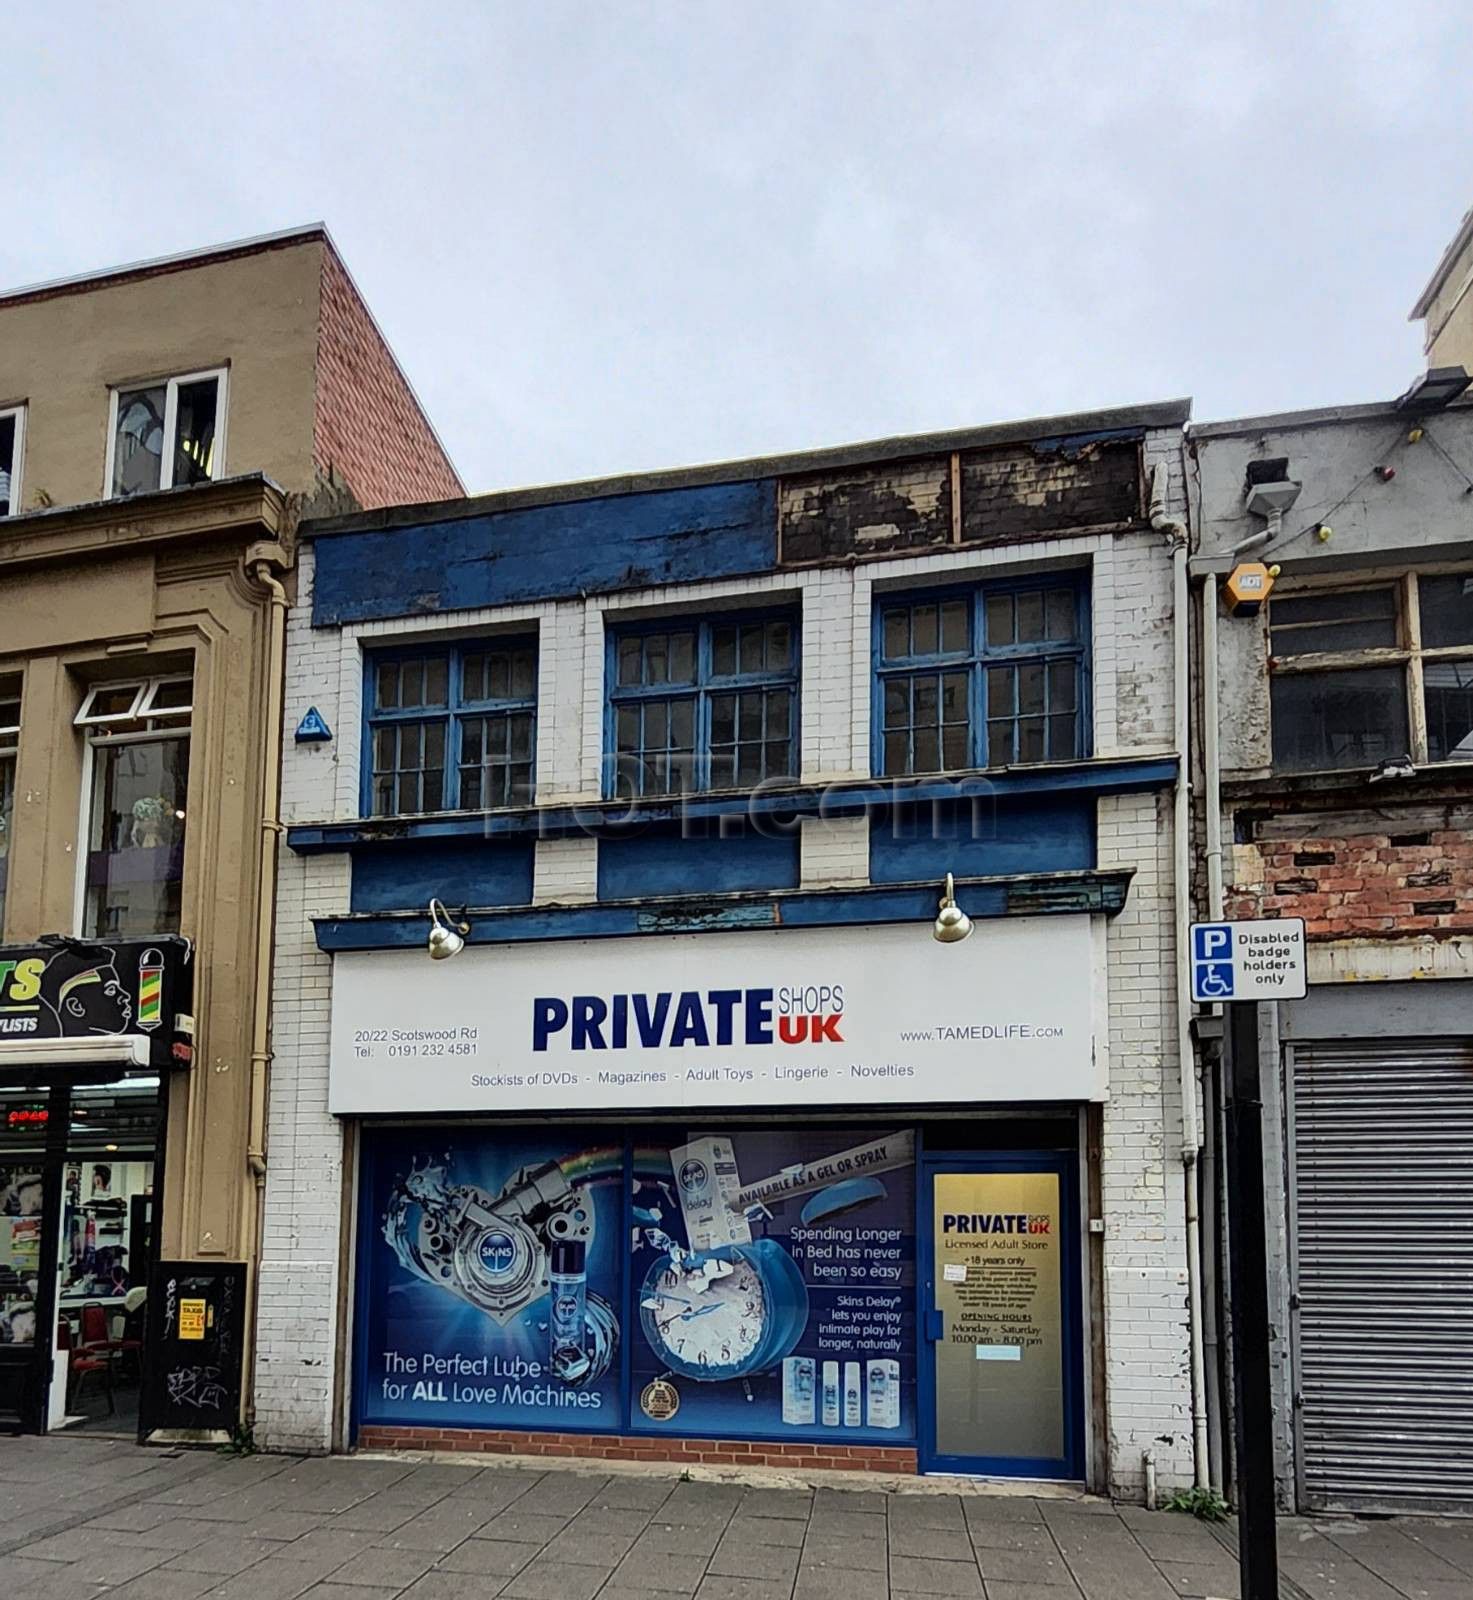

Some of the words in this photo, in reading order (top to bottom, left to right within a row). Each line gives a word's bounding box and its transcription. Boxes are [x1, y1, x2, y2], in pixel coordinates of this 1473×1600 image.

[1238, 931, 1300, 945] Disabled
[1248, 947, 1290, 958] badge
[1243, 960, 1296, 971] holders
[1255, 973, 1285, 985] only
[532, 988, 774, 1052] PRIVATE
[778, 985, 844, 1014] SHOPS
[354, 1030, 389, 1042] 20/22
[391, 1027, 457, 1041] Scotswood
[460, 1027, 478, 1040] Rd
[778, 1014, 845, 1044] UK
[354, 1046, 374, 1058] Tel:
[388, 1045, 418, 1057] 0191
[421, 1044, 445, 1056] 232
[447, 1043, 478, 1055] 4581
[471, 1073, 524, 1087] Stockists
[527, 1073, 539, 1085] of
[542, 1072, 578, 1085] DVDs
[598, 1070, 667, 1085] Magazines
[686, 1067, 719, 1081] Adult
[723, 1067, 754, 1083] Toys
[774, 1065, 829, 1081] Lingerie
[850, 1063, 915, 1078] Novelties
[738, 1178, 791, 1204] AVAILABLE
[792, 1173, 806, 1188] AS
[808, 1171, 816, 1182] A
[817, 1165, 837, 1180] GEL
[837, 1158, 853, 1173] OR
[855, 1146, 888, 1168] SPRAY
[943, 1214, 1027, 1234] PRIVATE
[1028, 1223, 1051, 1234] UK
[790, 1226, 853, 1244] Spending
[855, 1227, 902, 1244] Longer
[792, 1245, 804, 1259] in
[807, 1245, 833, 1259] Bed
[836, 1245, 861, 1259] has
[864, 1248, 902, 1259] never
[945, 1240, 989, 1250] Licensed
[991, 1240, 1019, 1250] Adult
[1022, 1240, 1049, 1250] Store
[982, 1257, 1006, 1266] years
[1007, 1257, 1026, 1266] only
[813, 1262, 848, 1277] been
[850, 1266, 867, 1277] so
[869, 1266, 902, 1281] easy
[837, 1295, 864, 1307] Skins
[831, 1308, 850, 1321] lets
[852, 1311, 871, 1324] you
[873, 1310, 902, 1325] enjoy
[961, 1313, 999, 1321] OPENING
[1002, 1314, 1032, 1322] HOURS
[818, 1323, 861, 1335] intimate
[863, 1323, 885, 1338] play
[887, 1323, 902, 1336] for
[952, 1323, 992, 1335] Monday
[1000, 1324, 1041, 1337] Saturday
[818, 1337, 854, 1351] longer,
[856, 1338, 902, 1353] naturally
[1026, 1338, 1043, 1347] pm
[383, 1352, 418, 1374] The
[423, 1353, 488, 1376] Perfect
[494, 1355, 541, 1378] Lube
[382, 1378, 408, 1400] for
[412, 1380, 448, 1401] ALL
[453, 1382, 497, 1403] Love
[502, 1384, 602, 1409] Machines
